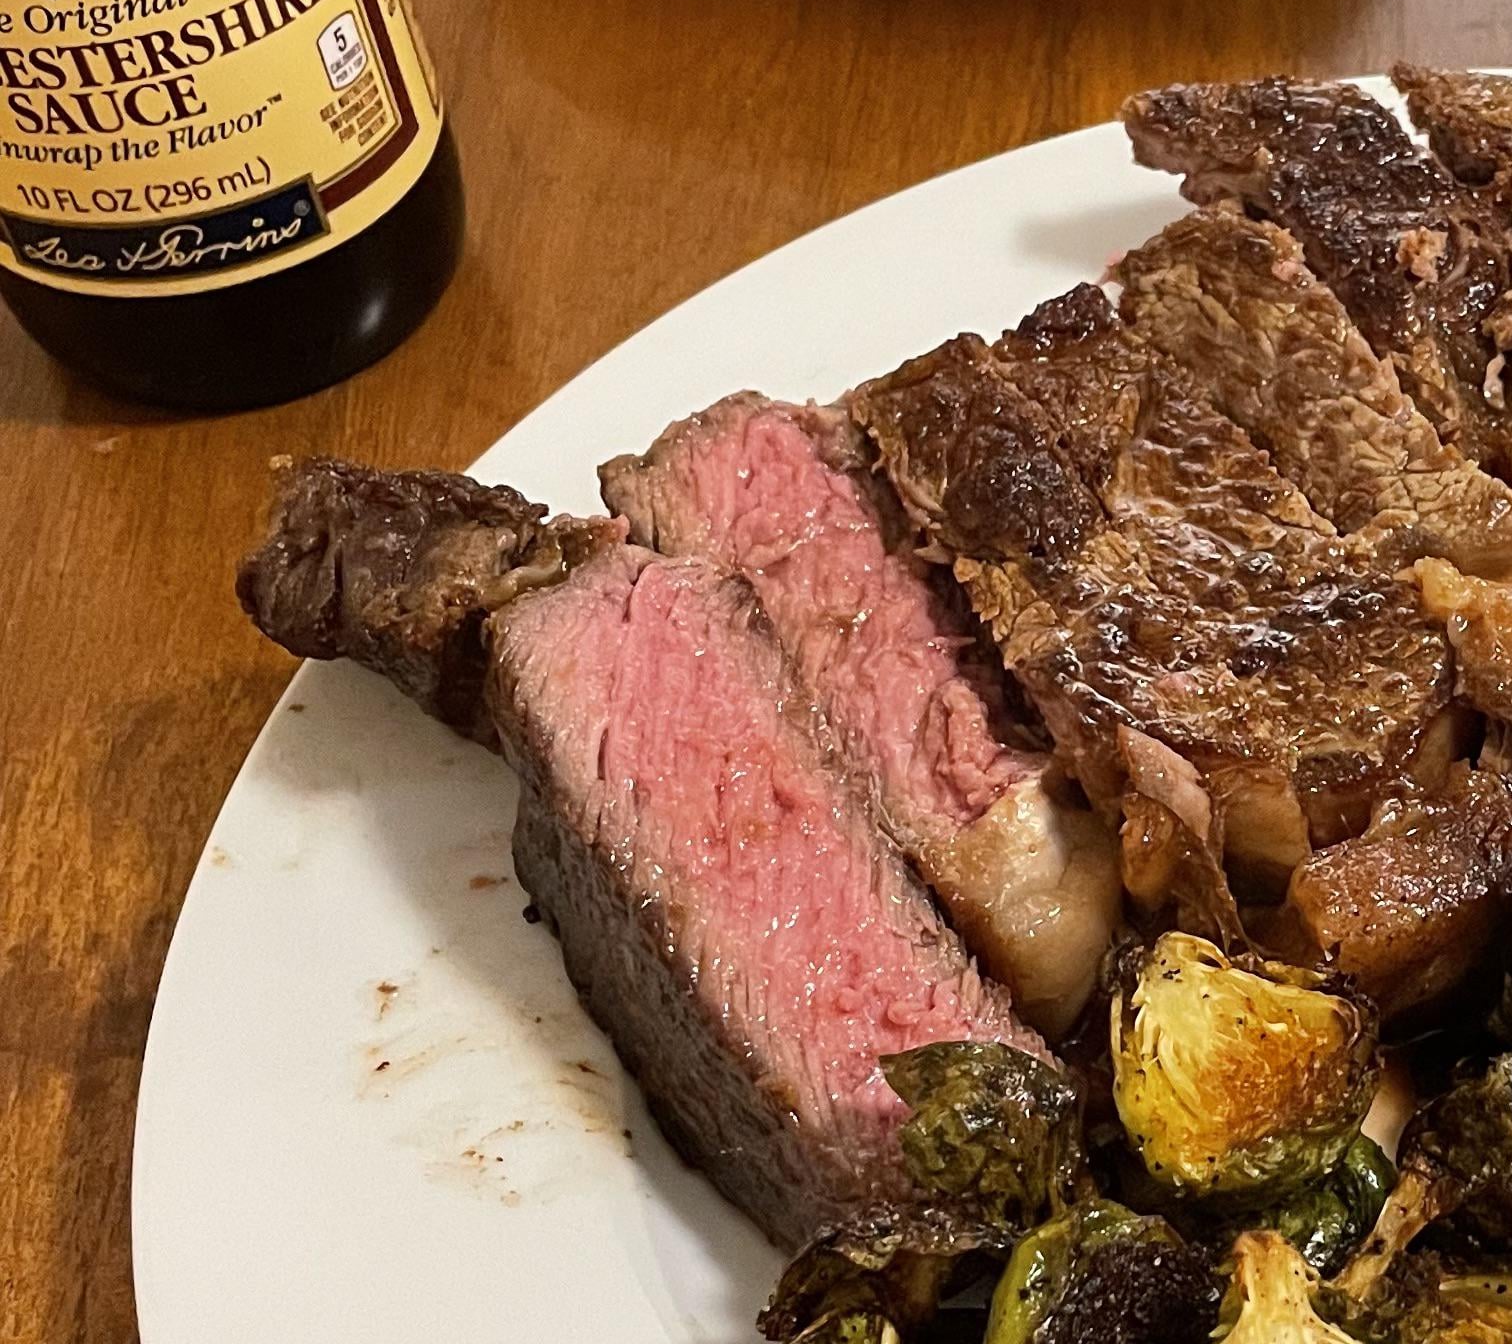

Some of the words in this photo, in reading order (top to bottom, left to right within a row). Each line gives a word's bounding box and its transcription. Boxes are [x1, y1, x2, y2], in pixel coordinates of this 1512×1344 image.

[333, 26, 347, 52] 5
[8, 74, 207, 135] SAUCE
[0, 138, 102, 171] nwrap
[111, 137, 160, 162] the
[17, 184, 50, 208] 10
[50, 190, 89, 214] FL
[92, 189, 140, 212] OZ
[145, 179, 212, 213] (296
[217, 156, 271, 195] mL)
